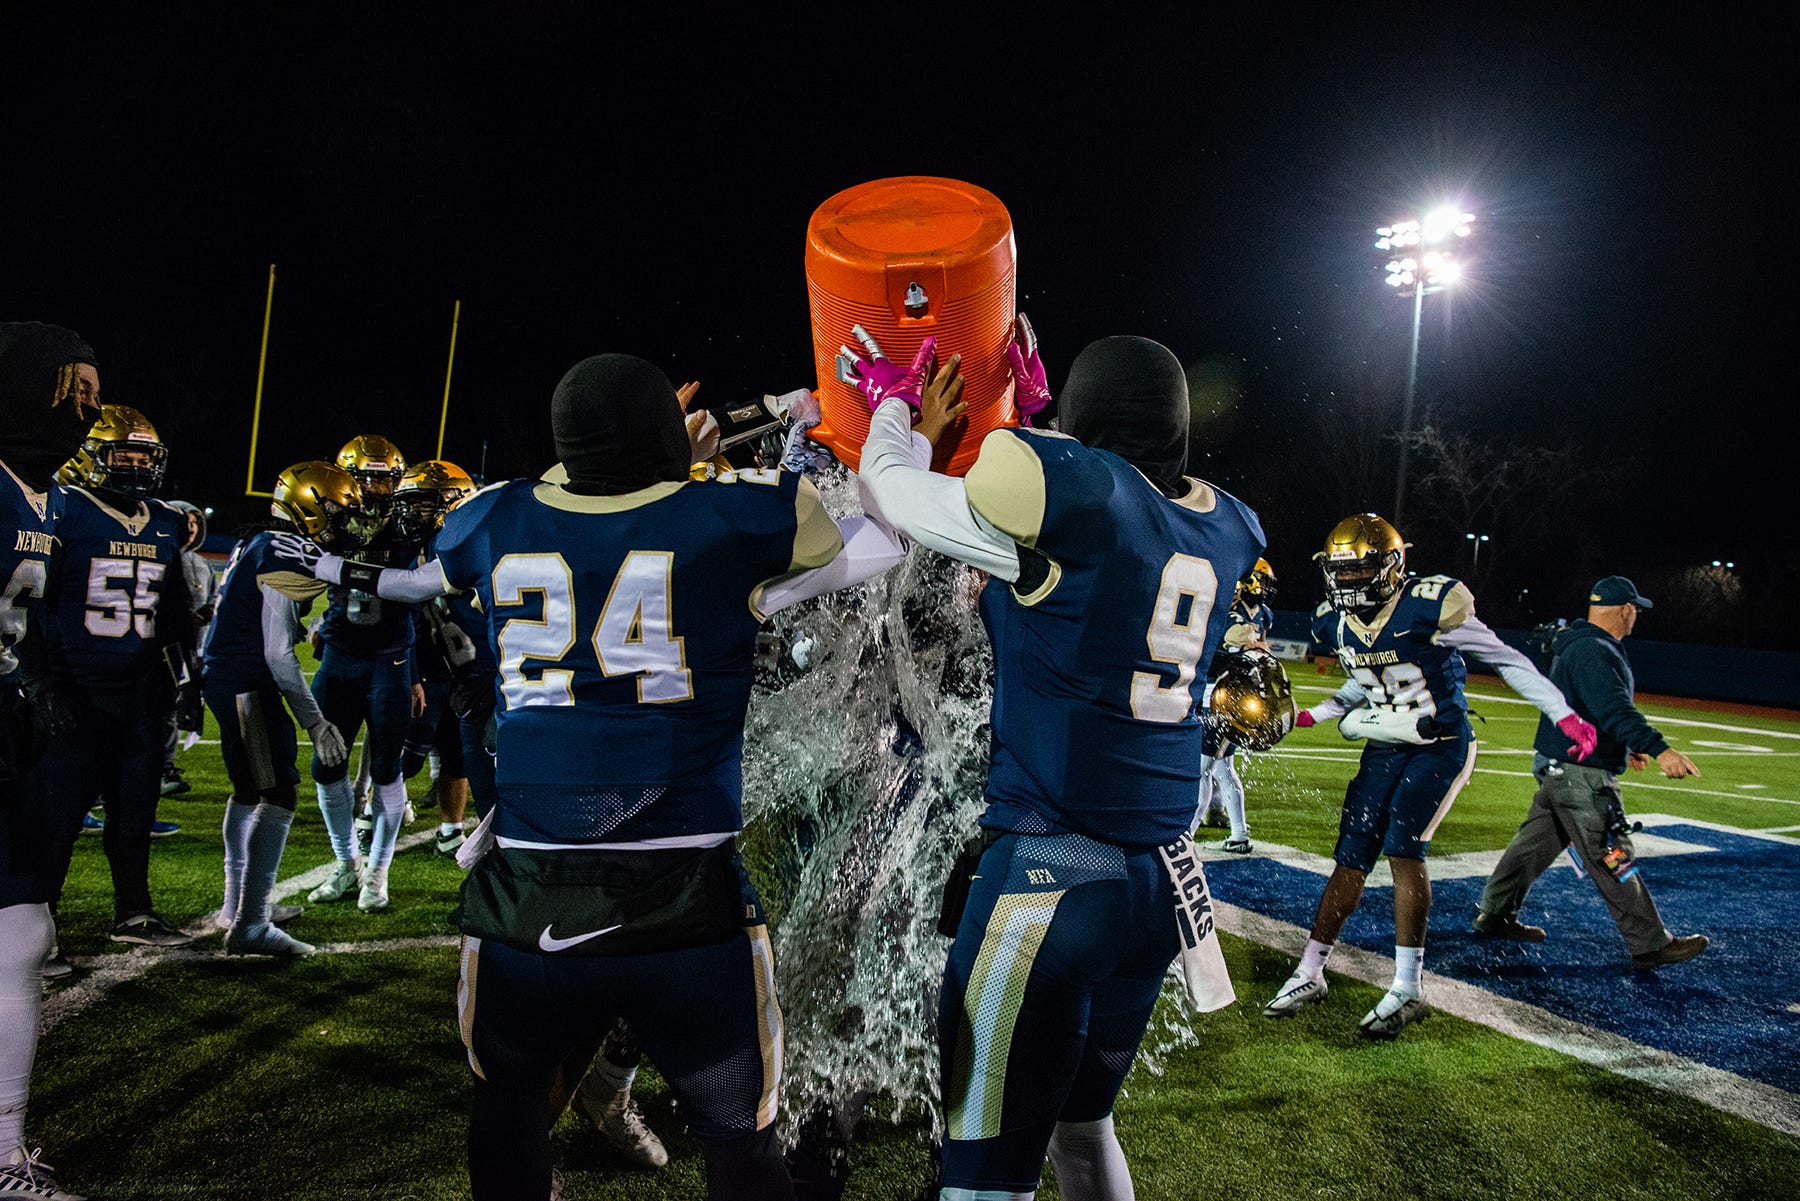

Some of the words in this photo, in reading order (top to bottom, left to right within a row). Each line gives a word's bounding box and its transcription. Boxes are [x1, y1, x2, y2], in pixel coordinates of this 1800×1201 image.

[109, 540, 158, 560] NEWBURGH
[84, 557, 167, 639] 55
[492, 550, 694, 710] 24
[1129, 551, 1219, 723] 9
[1364, 632, 1373, 645] N
[1025, 868, 1057, 885] NFA
[1164, 839, 1214, 942] BACKS
